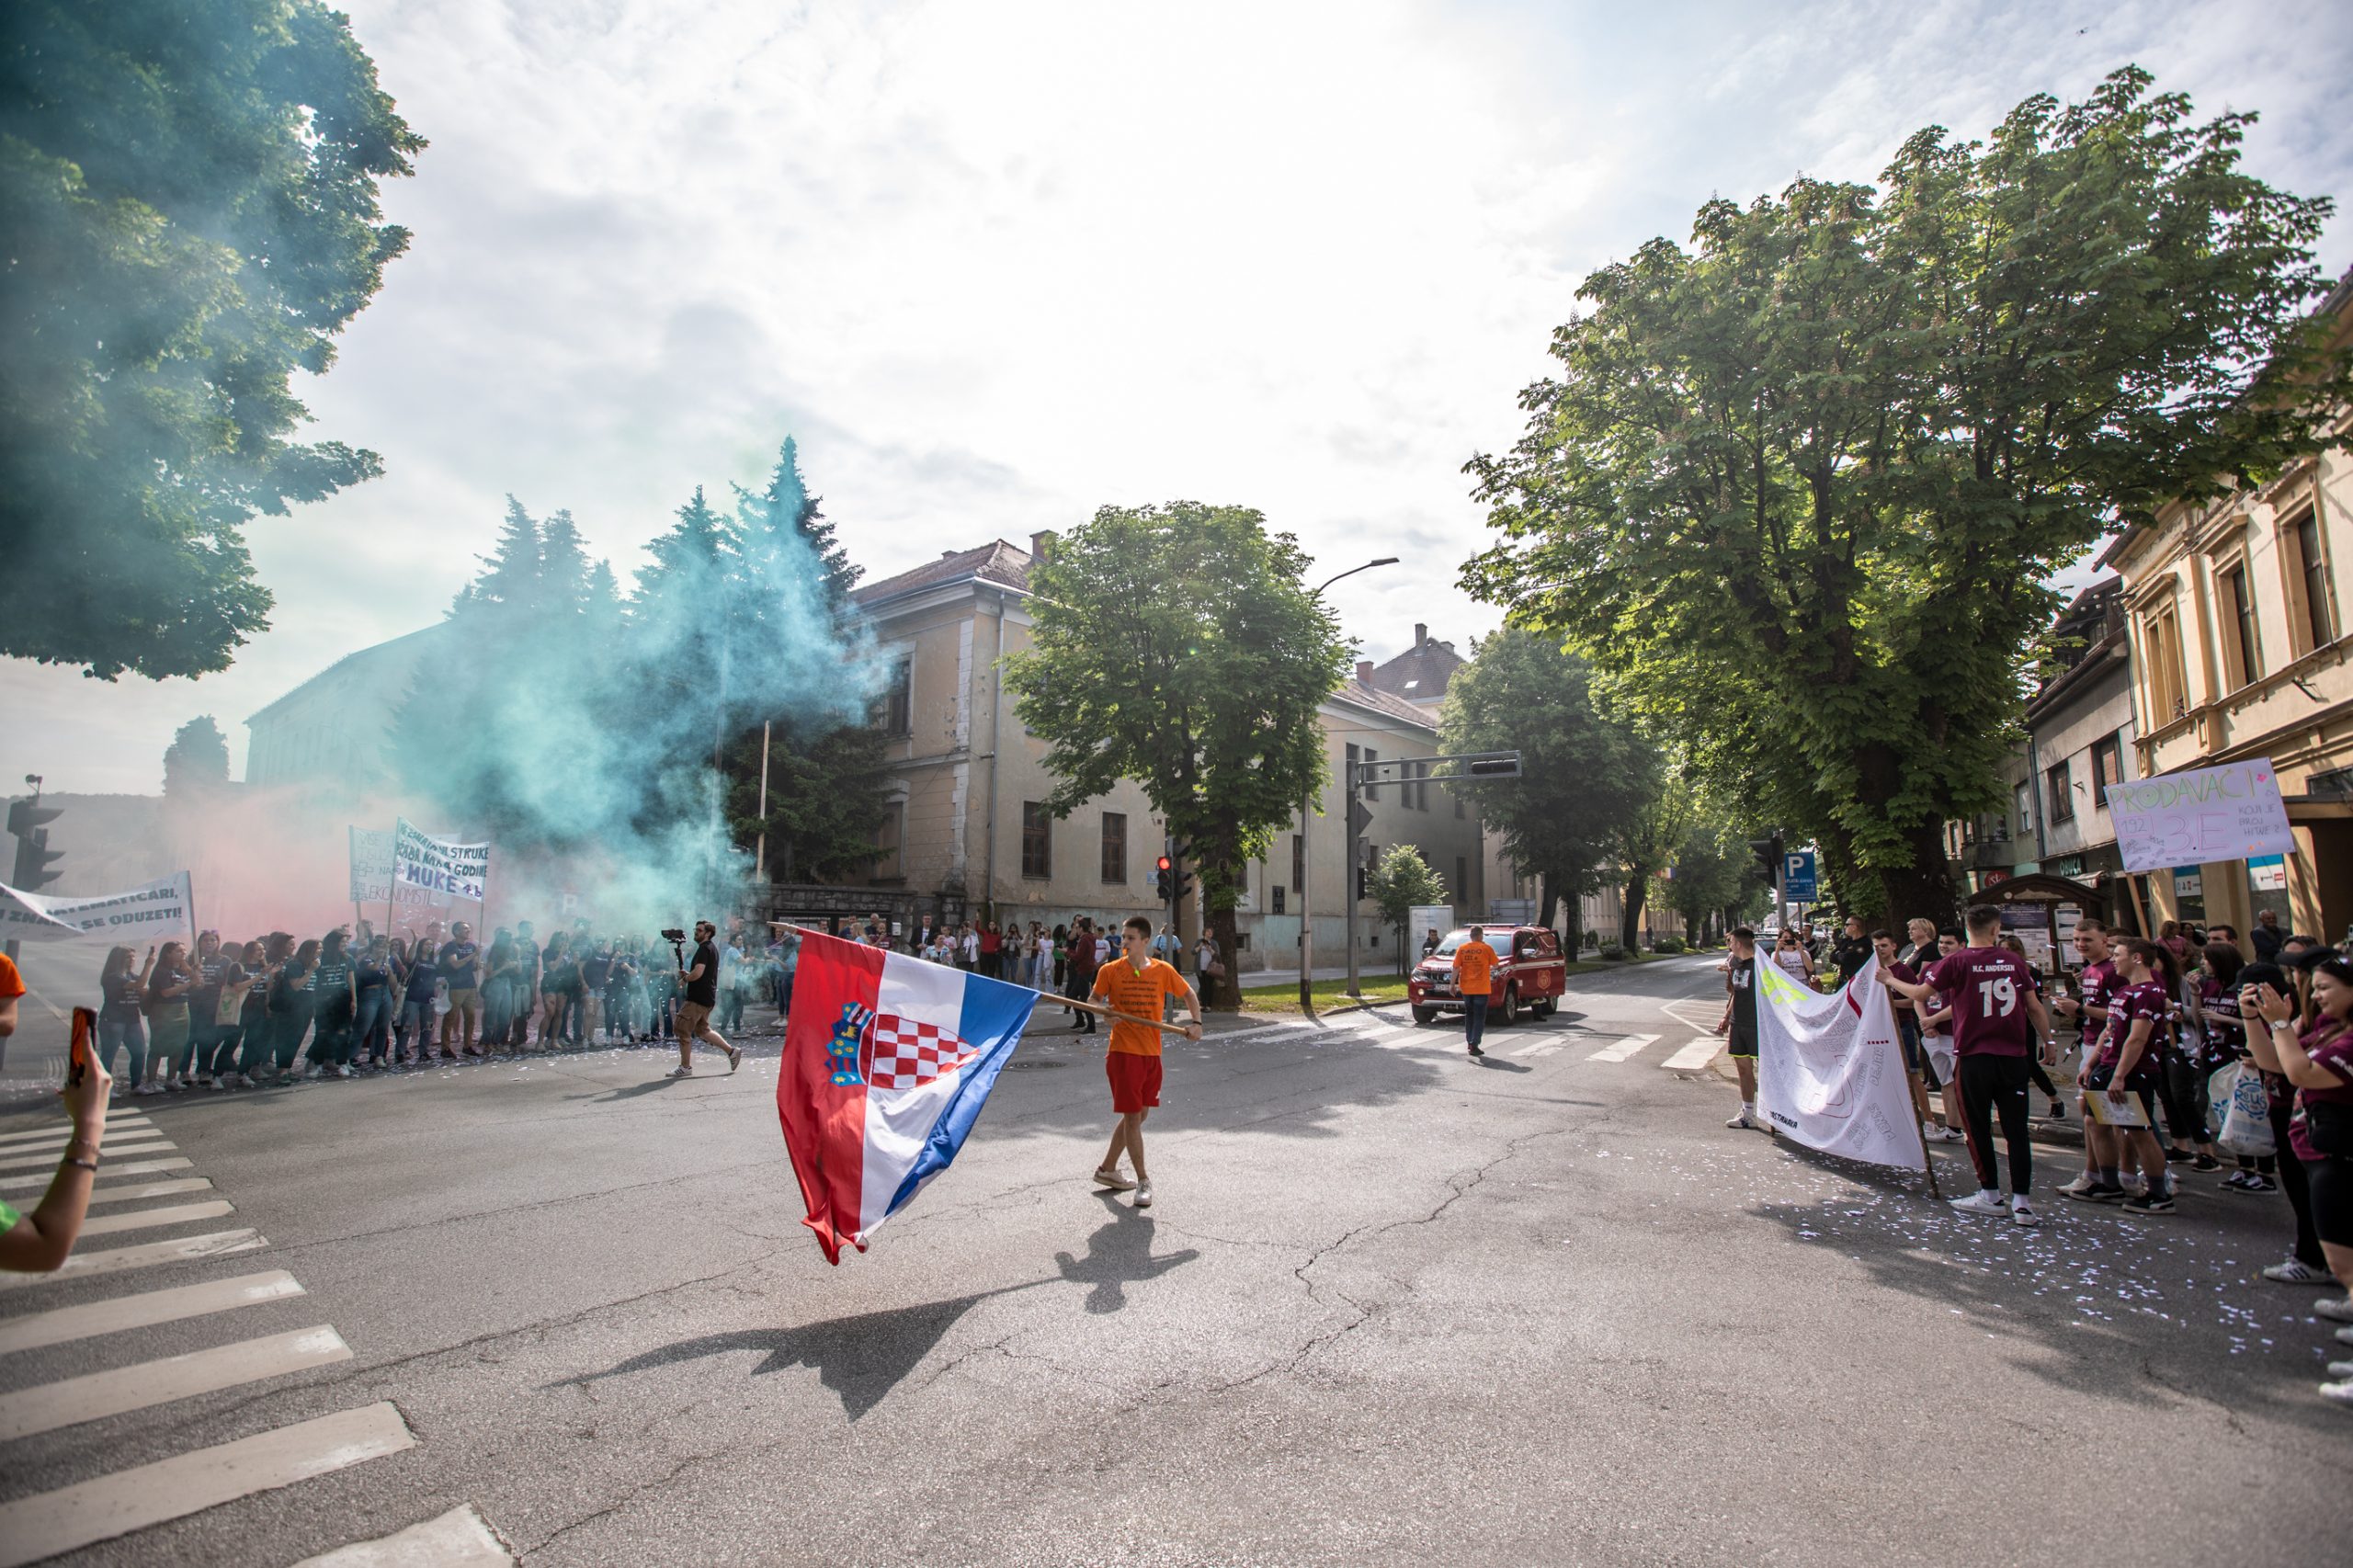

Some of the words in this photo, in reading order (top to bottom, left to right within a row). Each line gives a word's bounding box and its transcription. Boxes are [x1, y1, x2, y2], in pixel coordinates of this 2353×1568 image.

[450, 846, 489, 860] STRUKE
[406, 862, 458, 894] MUKE
[1788, 856, 1805, 878] P
[80, 917, 107, 930] SE
[108, 906, 183, 926] ODUZETI!
[1985, 964, 2016, 972] ANDERSEN
[1979, 977, 2017, 1018] 19
